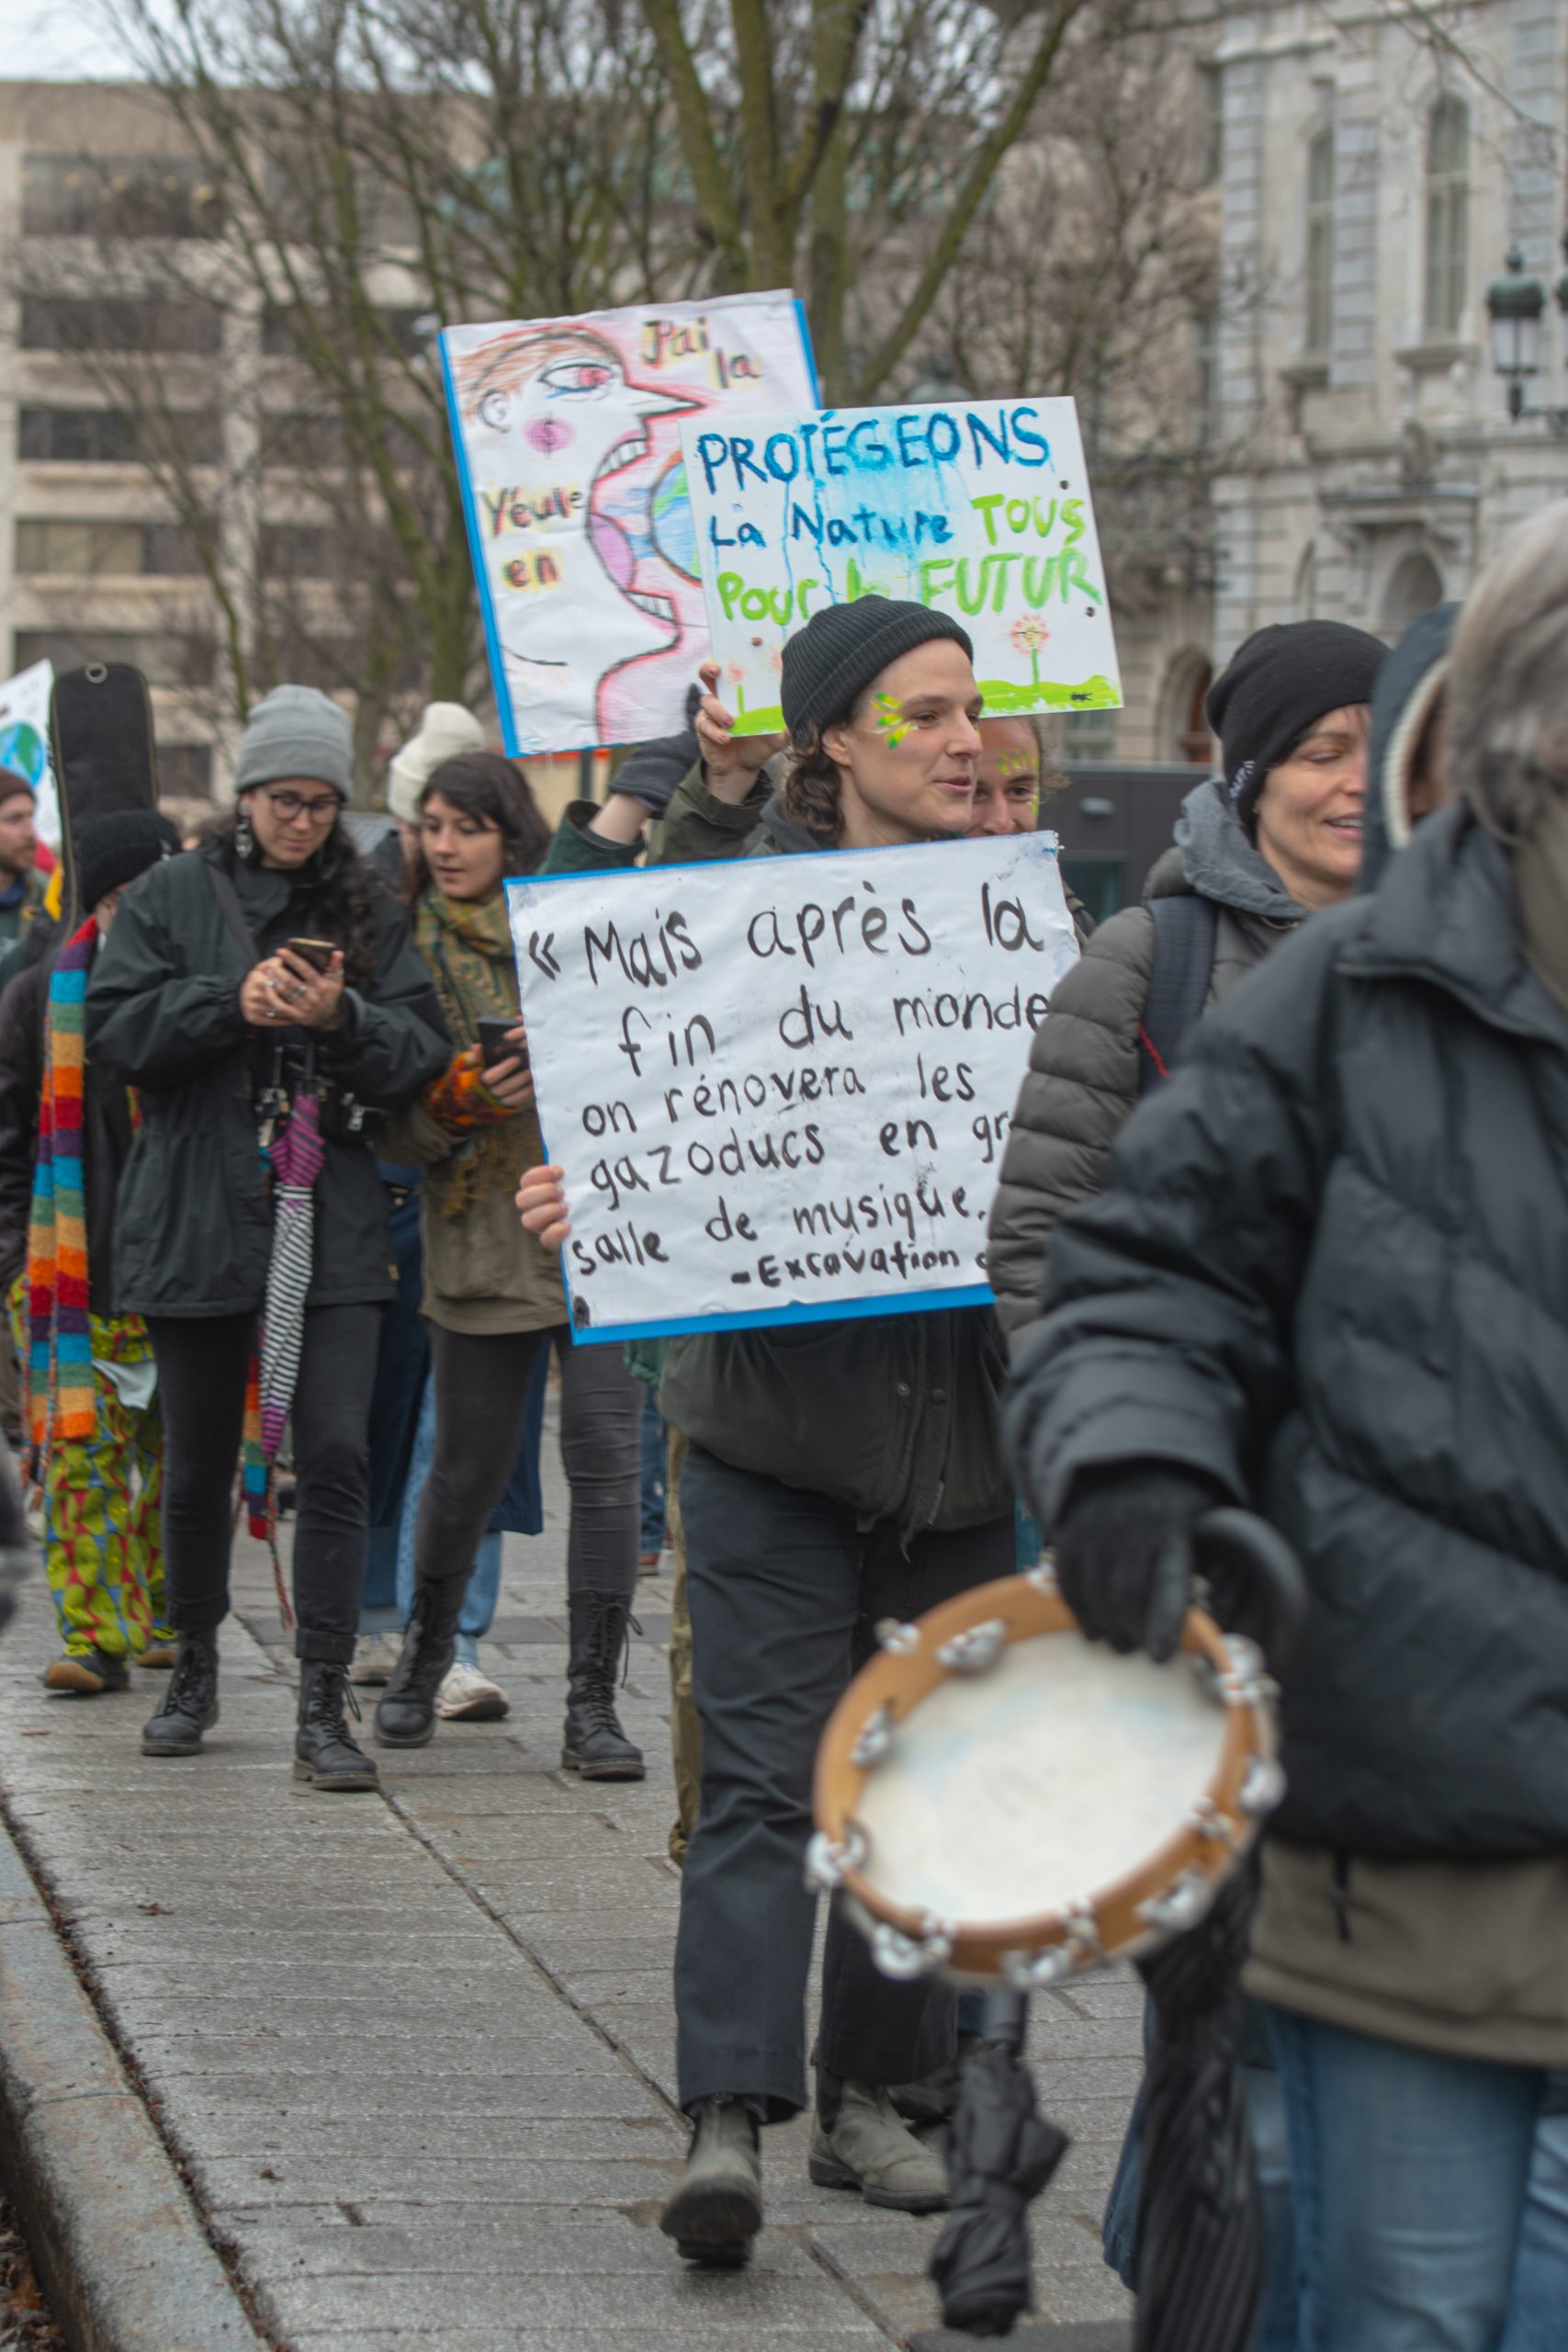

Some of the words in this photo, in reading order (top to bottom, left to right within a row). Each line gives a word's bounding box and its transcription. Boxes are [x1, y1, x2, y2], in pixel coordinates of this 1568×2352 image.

[716, 347, 763, 389] la
[697, 407, 1053, 493] PROTÉGEONS
[710, 515, 765, 546] La
[792, 502, 954, 546] Nature
[971, 493, 1087, 545] TOUS
[504, 553, 558, 586] en
[919, 548, 1103, 616] FUTUR
[748, 880, 931, 967] après
[981, 882, 1043, 951] la
[618, 1006, 715, 1076] fin
[779, 985, 852, 1048] du
[893, 986, 1049, 1036] monde
[582, 1099, 637, 1136] on
[665, 1066, 866, 1123] rénovera
[918, 1054, 976, 1102] les
[591, 1123, 825, 1210] gazoducs
[879, 1118, 938, 1156] en
[973, 1111, 1014, 1163] gr
[572, 1222, 669, 1275] salle
[705, 1196, 757, 1243] de
